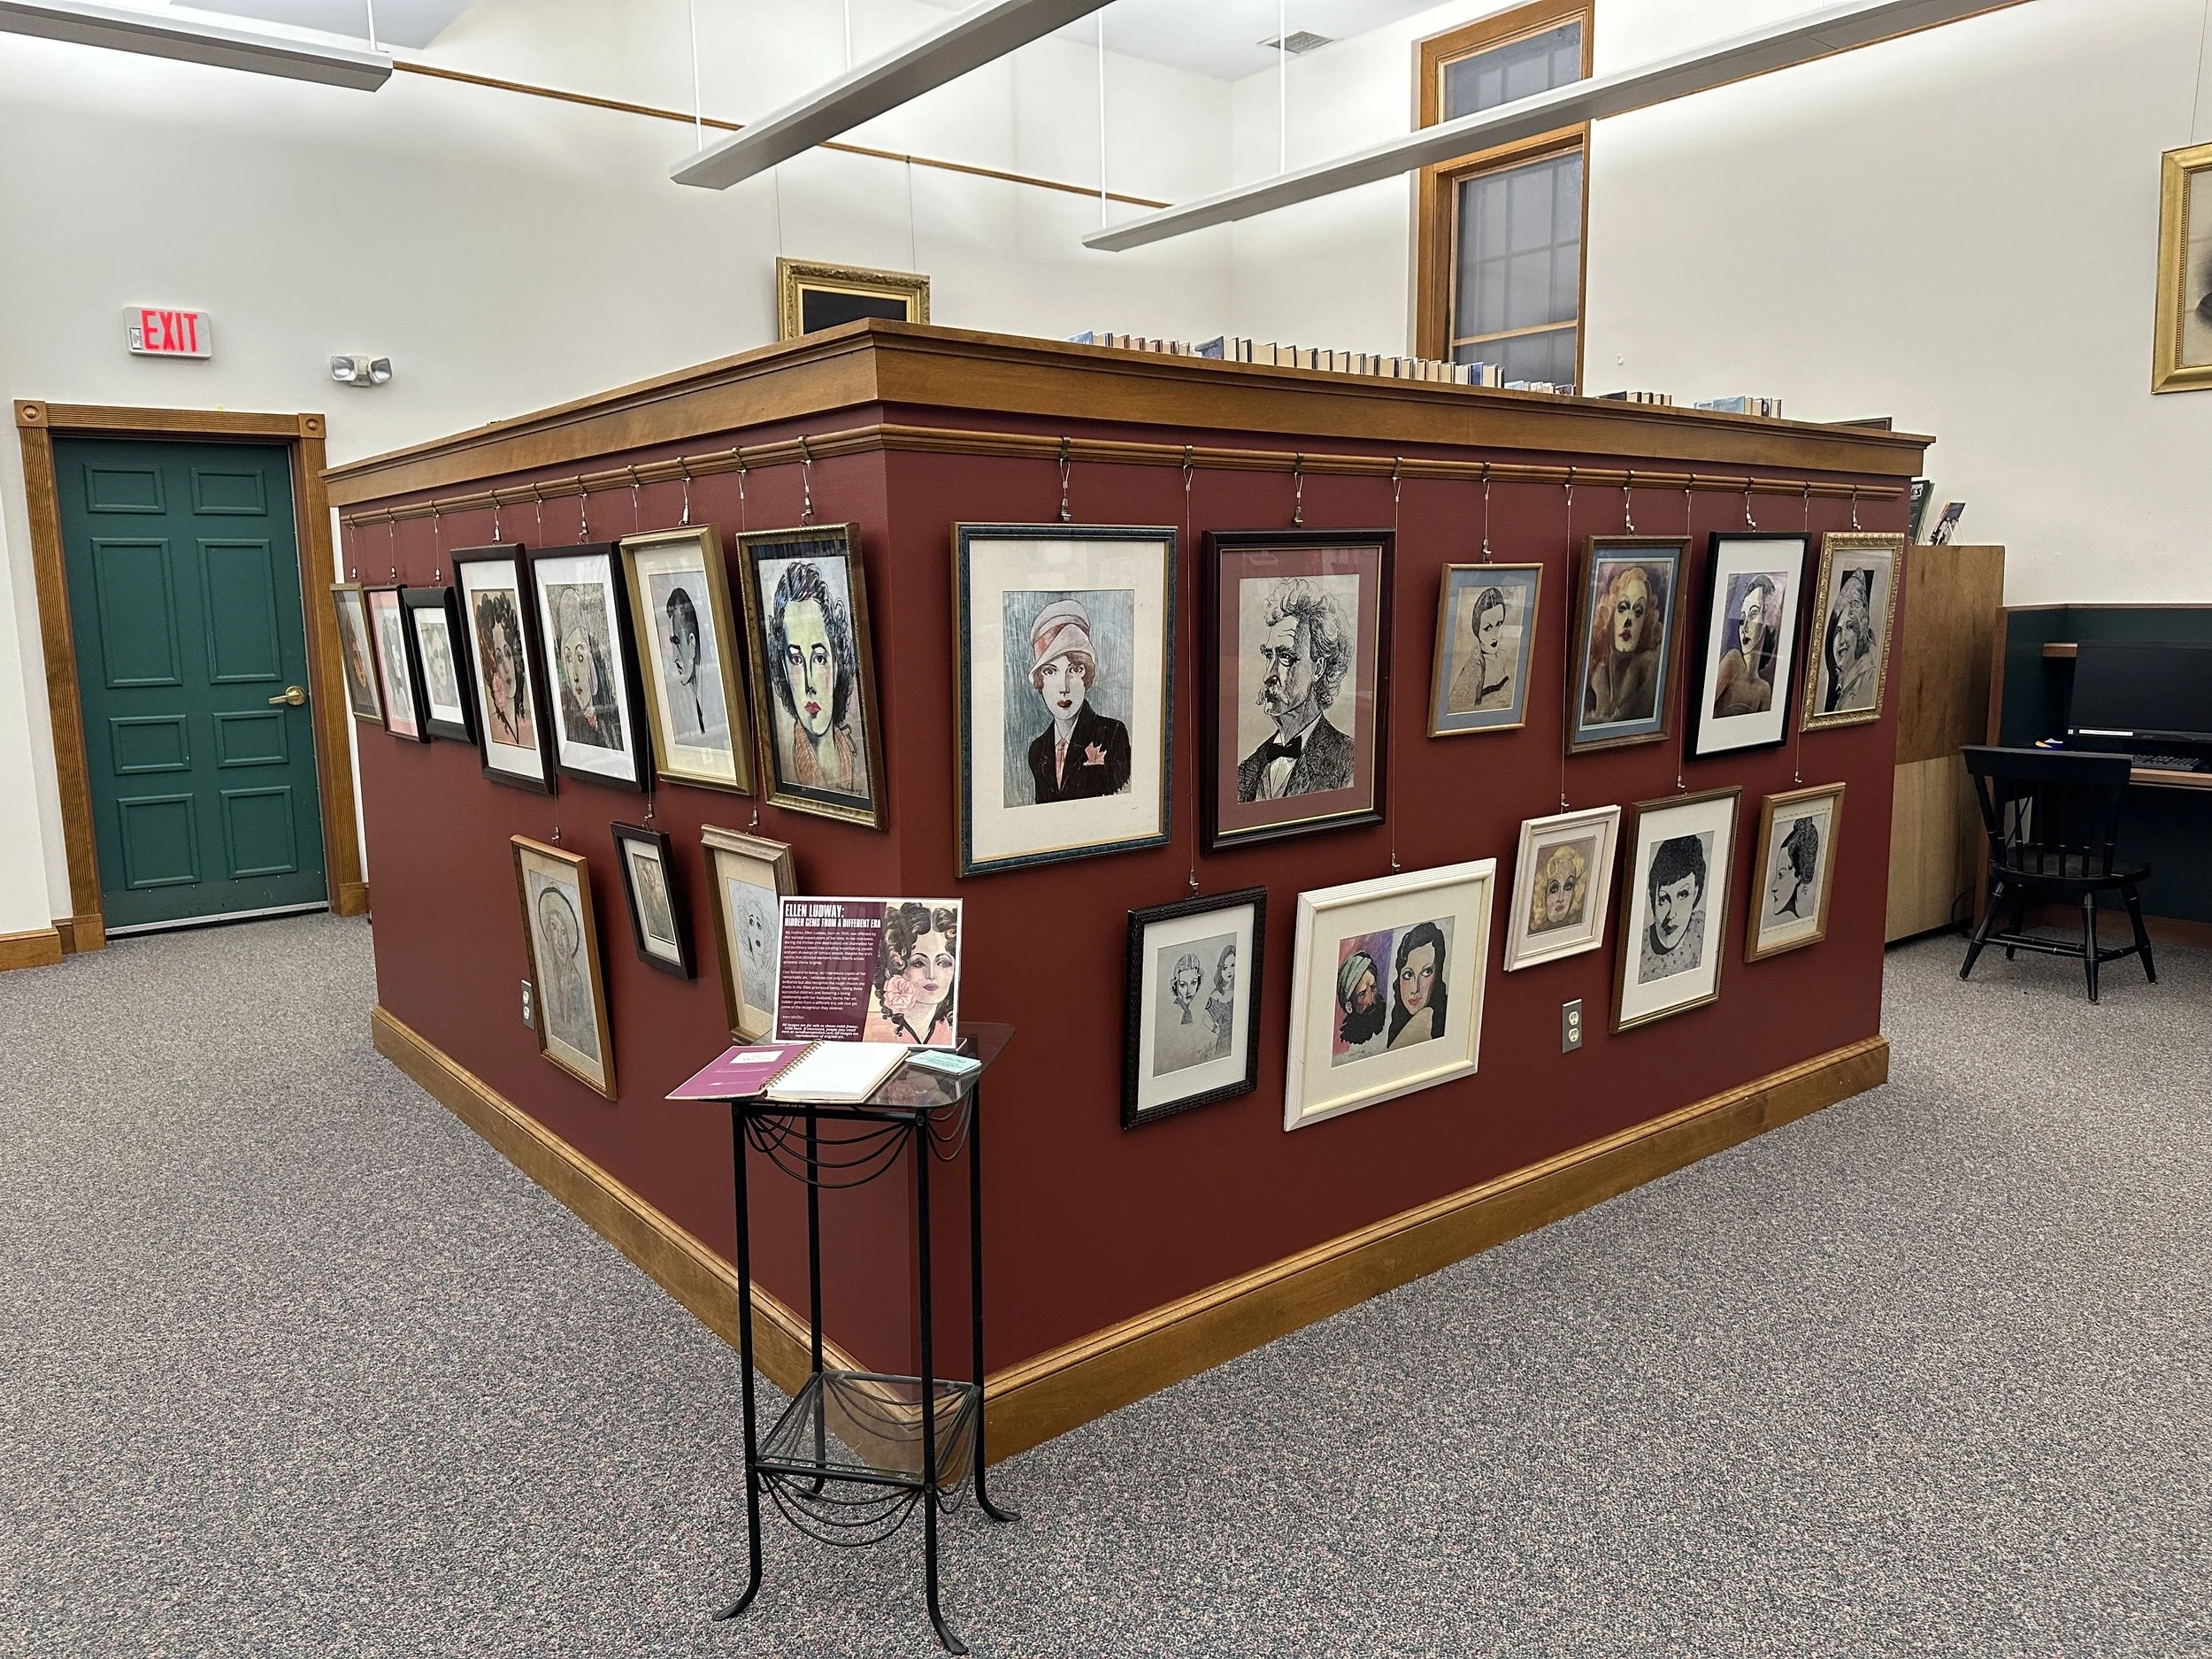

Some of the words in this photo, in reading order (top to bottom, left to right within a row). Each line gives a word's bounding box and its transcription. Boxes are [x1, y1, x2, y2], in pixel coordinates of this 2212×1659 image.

[141, 309, 198, 352] EXIT
[786, 904, 807, 917] ELLEN
[809, 904, 845, 918] LUDWAY:
[785, 918, 805, 926] HIDDEN
[805, 918, 820, 927] GEMS
[821, 918, 836, 927] FROM
[837, 918, 841, 927] A
[842, 918, 870, 928] DIFFERENT
[871, 919, 881, 928] ERA
